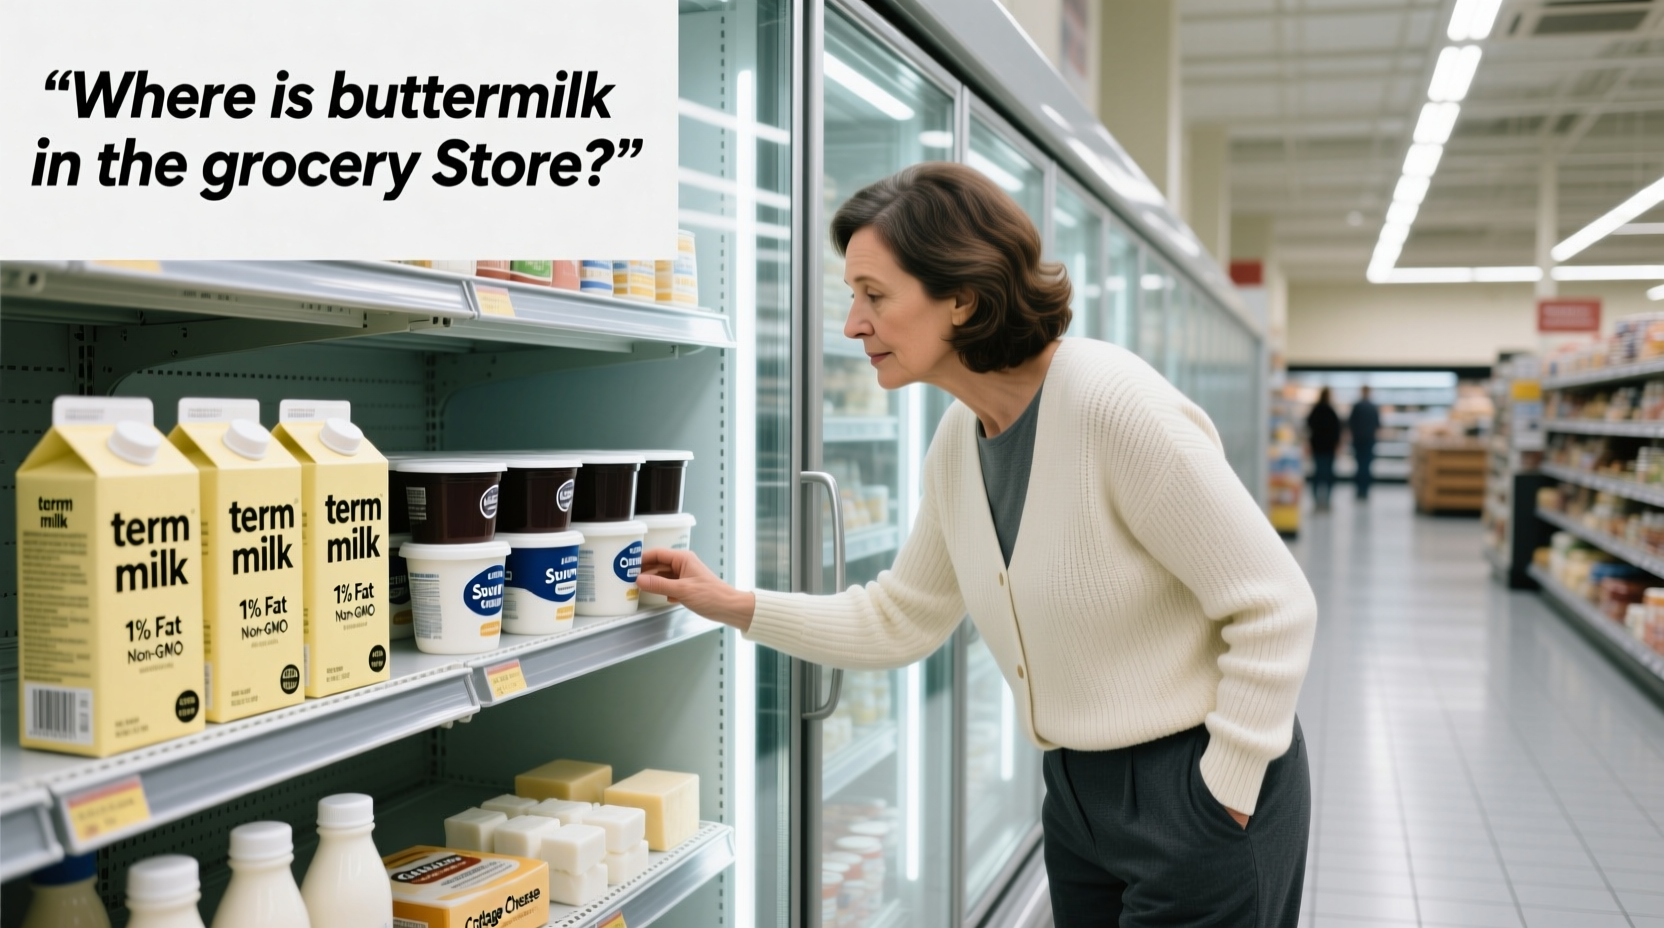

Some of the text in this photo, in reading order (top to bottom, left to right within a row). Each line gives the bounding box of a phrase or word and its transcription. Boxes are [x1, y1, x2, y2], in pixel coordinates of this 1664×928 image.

[229, 501, 295, 534] term
[324, 494, 382, 525] term
[110, 512, 190, 548] term
[327, 525, 381, 564] milk
[115, 548, 189, 593] milk
[232, 534, 294, 576] milk
[238, 595, 288, 620] 1% Fat
[333, 583, 353, 605] 1%
[354, 582, 375, 601] Fat
[125, 615, 183, 643] 1% Fat
[127, 640, 184, 665] Non-GMO
